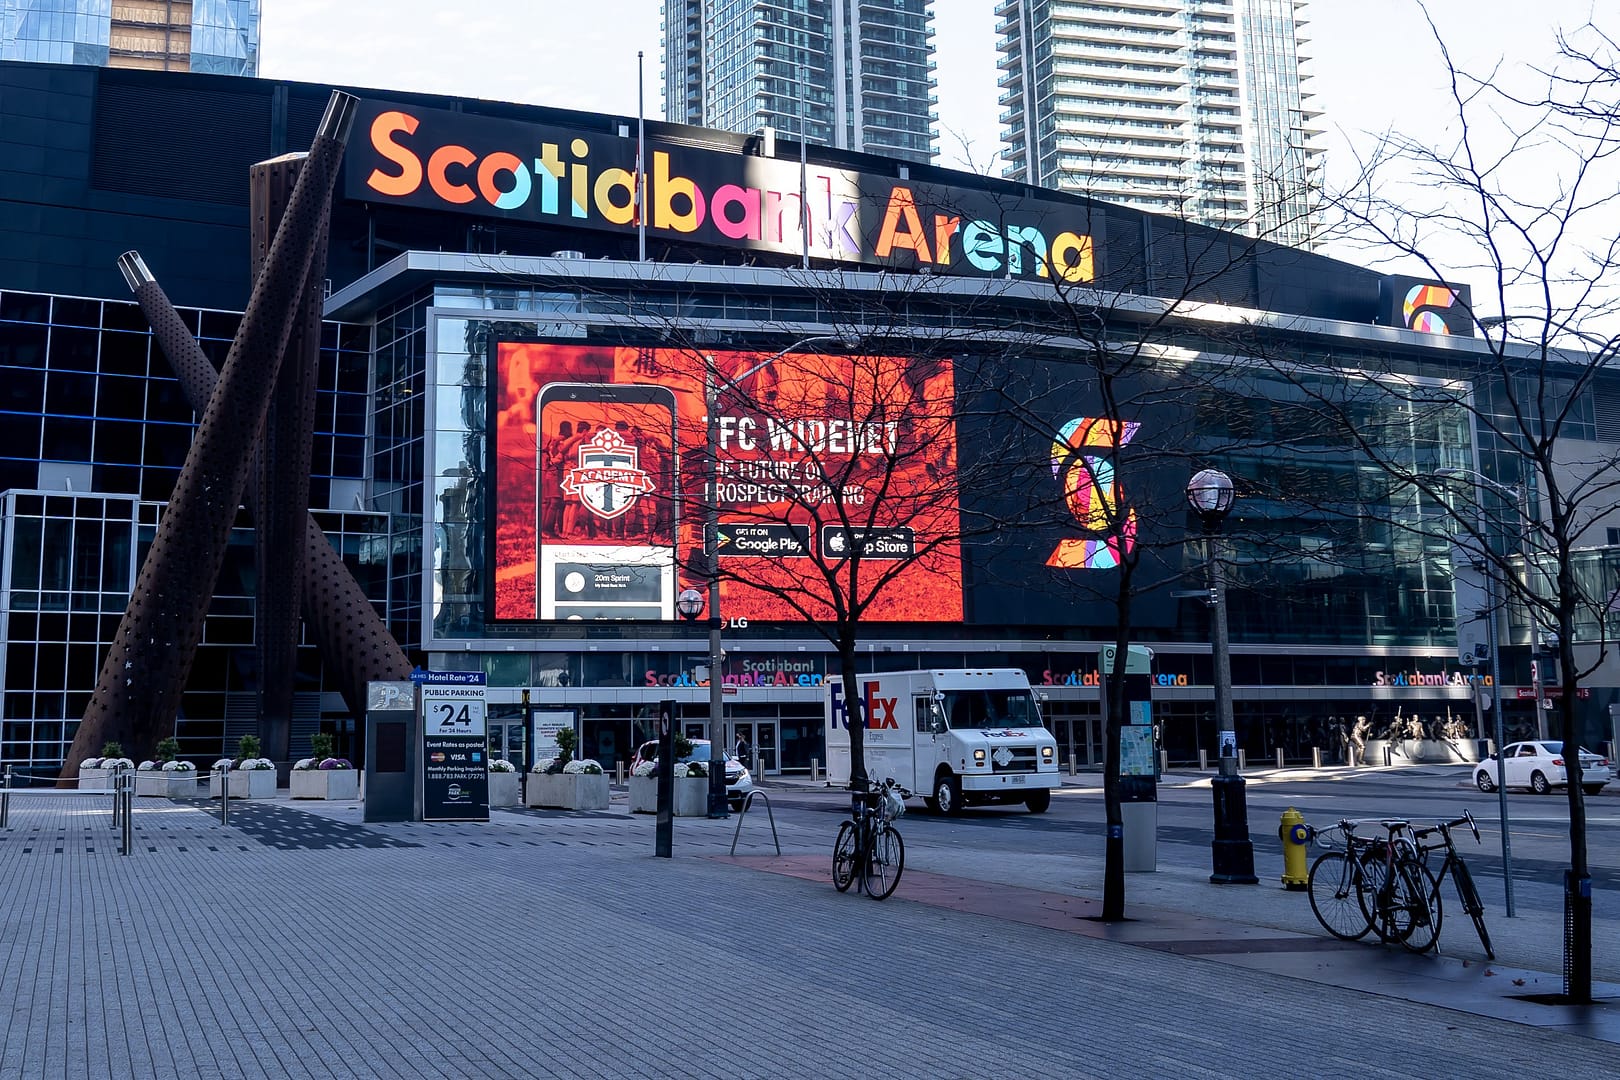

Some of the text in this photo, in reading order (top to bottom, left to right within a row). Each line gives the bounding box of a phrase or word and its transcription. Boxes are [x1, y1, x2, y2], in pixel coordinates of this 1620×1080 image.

[367, 110, 1095, 284] Scotiabank Arena
[704, 460, 735, 478] HE
[795, 484, 865, 505] TRAINNG
[735, 537, 779, 553] Google
[876, 540, 909, 553] Store
[594, 574, 630, 584] 20m Sprint
[730, 616, 748, 629] LG
[428, 673, 449, 681] Hotel
[449, 674, 466, 682] Rate
[645, 670, 765, 687] Scotiank
[1043, 669, 1188, 686] Scotiab rena
[1375, 670, 1451, 686] Scotiabank
[451, 689, 484, 697] PARKING
[980, 729, 1028, 738] FedEx
[465, 741, 485, 749] posted
[450, 753, 467, 761] VISA
